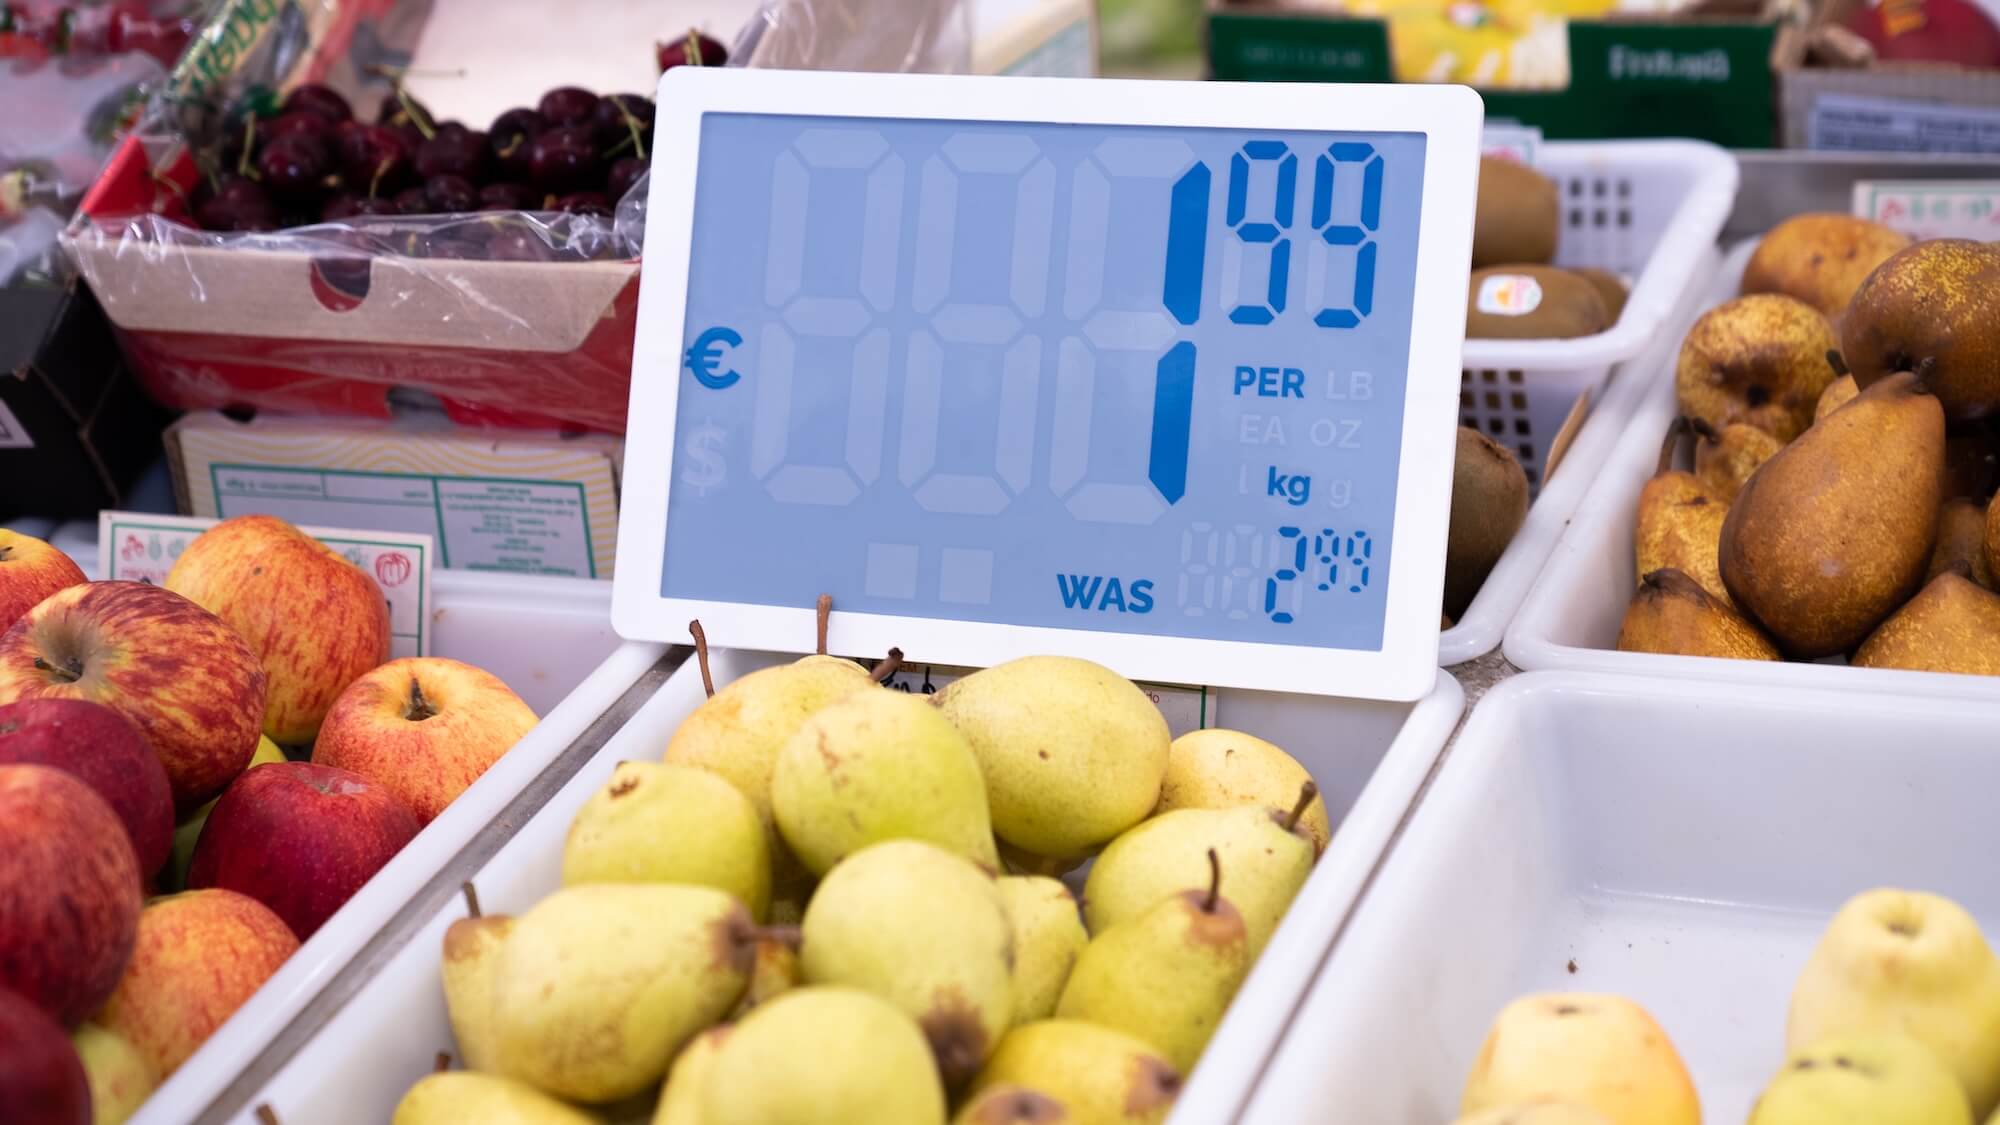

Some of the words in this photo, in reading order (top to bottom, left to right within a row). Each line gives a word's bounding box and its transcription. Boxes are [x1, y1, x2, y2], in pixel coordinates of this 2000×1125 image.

[1234, 366, 1305, 399] PER
[1326, 371, 1374, 400] LB
[1239, 414, 1287, 445] EA
[1310, 418, 1362, 448] OZ
[1267, 466, 1311, 506] kg
[1057, 574, 1154, 614] WAS
